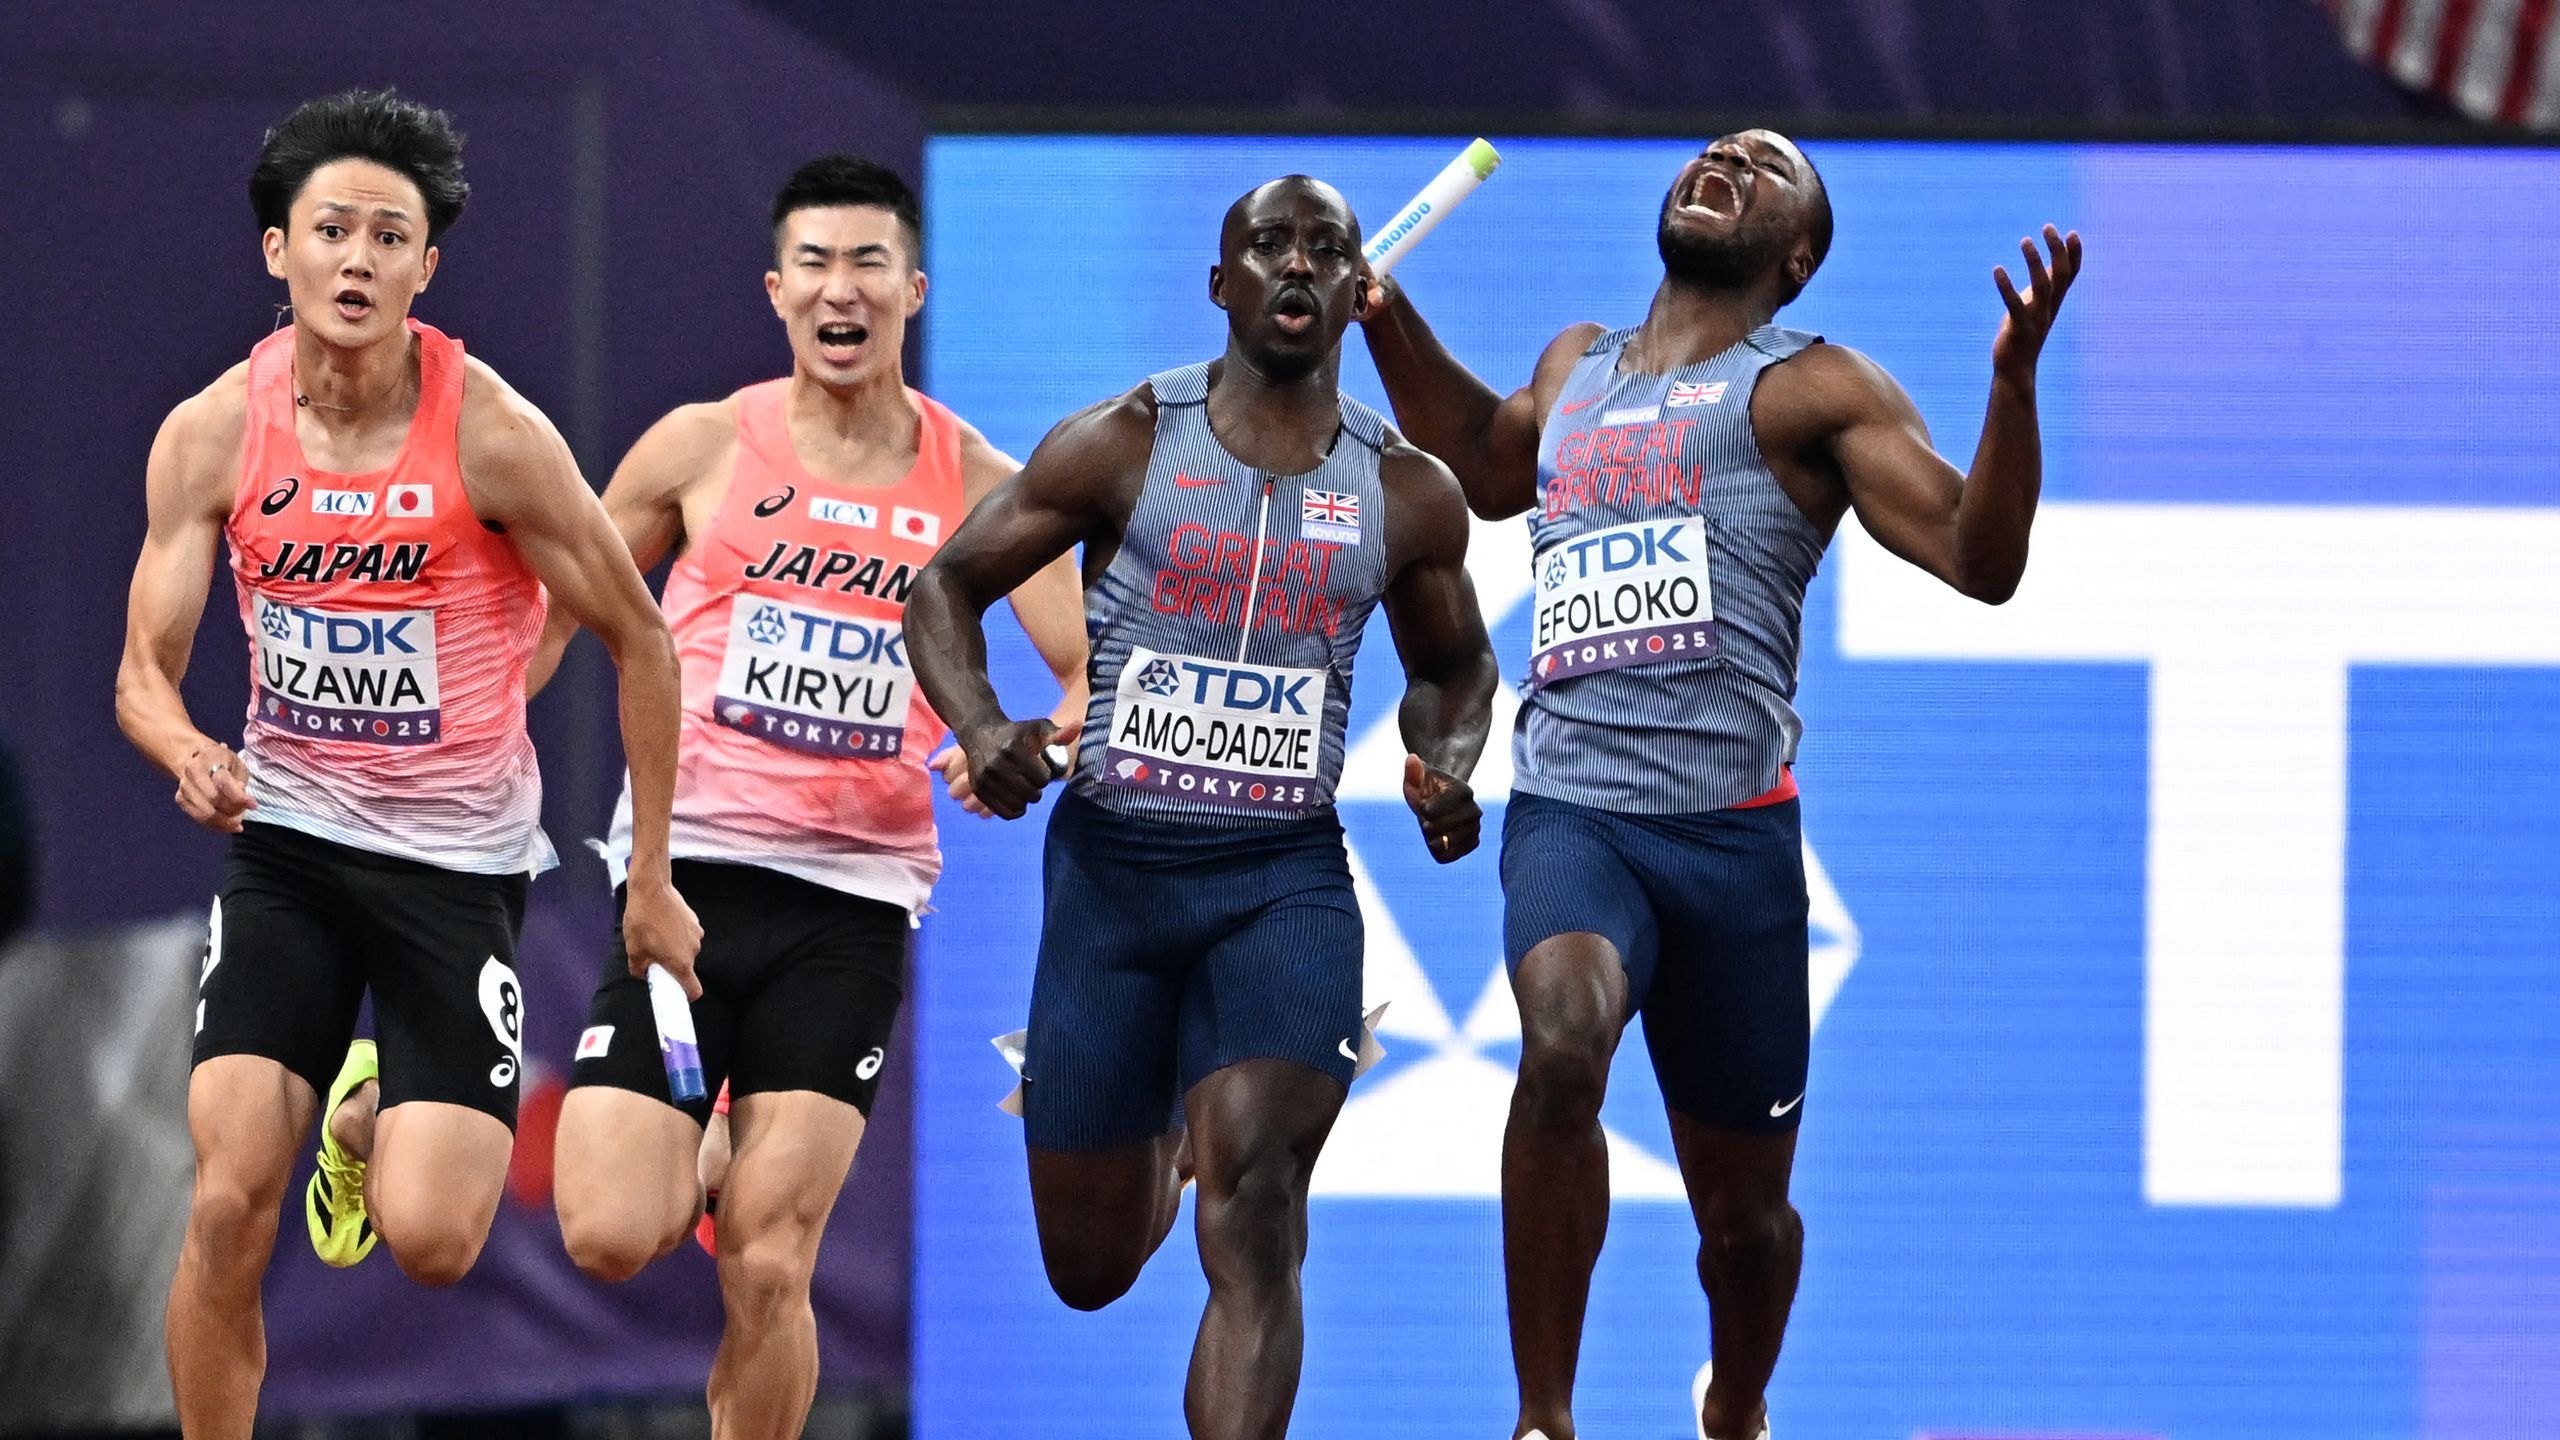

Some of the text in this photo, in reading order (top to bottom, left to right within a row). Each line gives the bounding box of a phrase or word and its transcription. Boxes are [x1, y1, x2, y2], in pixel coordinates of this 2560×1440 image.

[1375, 201, 1432, 256] MONDO
[1555, 420, 1697, 471] GREAT
[315, 491, 373, 513] ACN
[812, 501, 874, 526] ACN
[1546, 463, 1703, 521] BRITAIN
[260, 542, 430, 583] JAPAN
[744, 543, 922, 604] JAPAN
[1169, 523, 1342, 588] GREAT
[1567, 524, 1691, 579] TDK
[289, 608, 419, 656] TDK
[1152, 570, 1346, 638] BRITAIN
[1539, 576, 1699, 648] EFOLOKO
[791, 611, 905, 668] TDK
[263, 648, 426, 707] UZAWA
[744, 656, 894, 719] KIRYU
[1182, 661, 1310, 716] TDK
[1120, 704, 1312, 770] AMO-DADZIE
[499, 981, 519, 1042] 8
